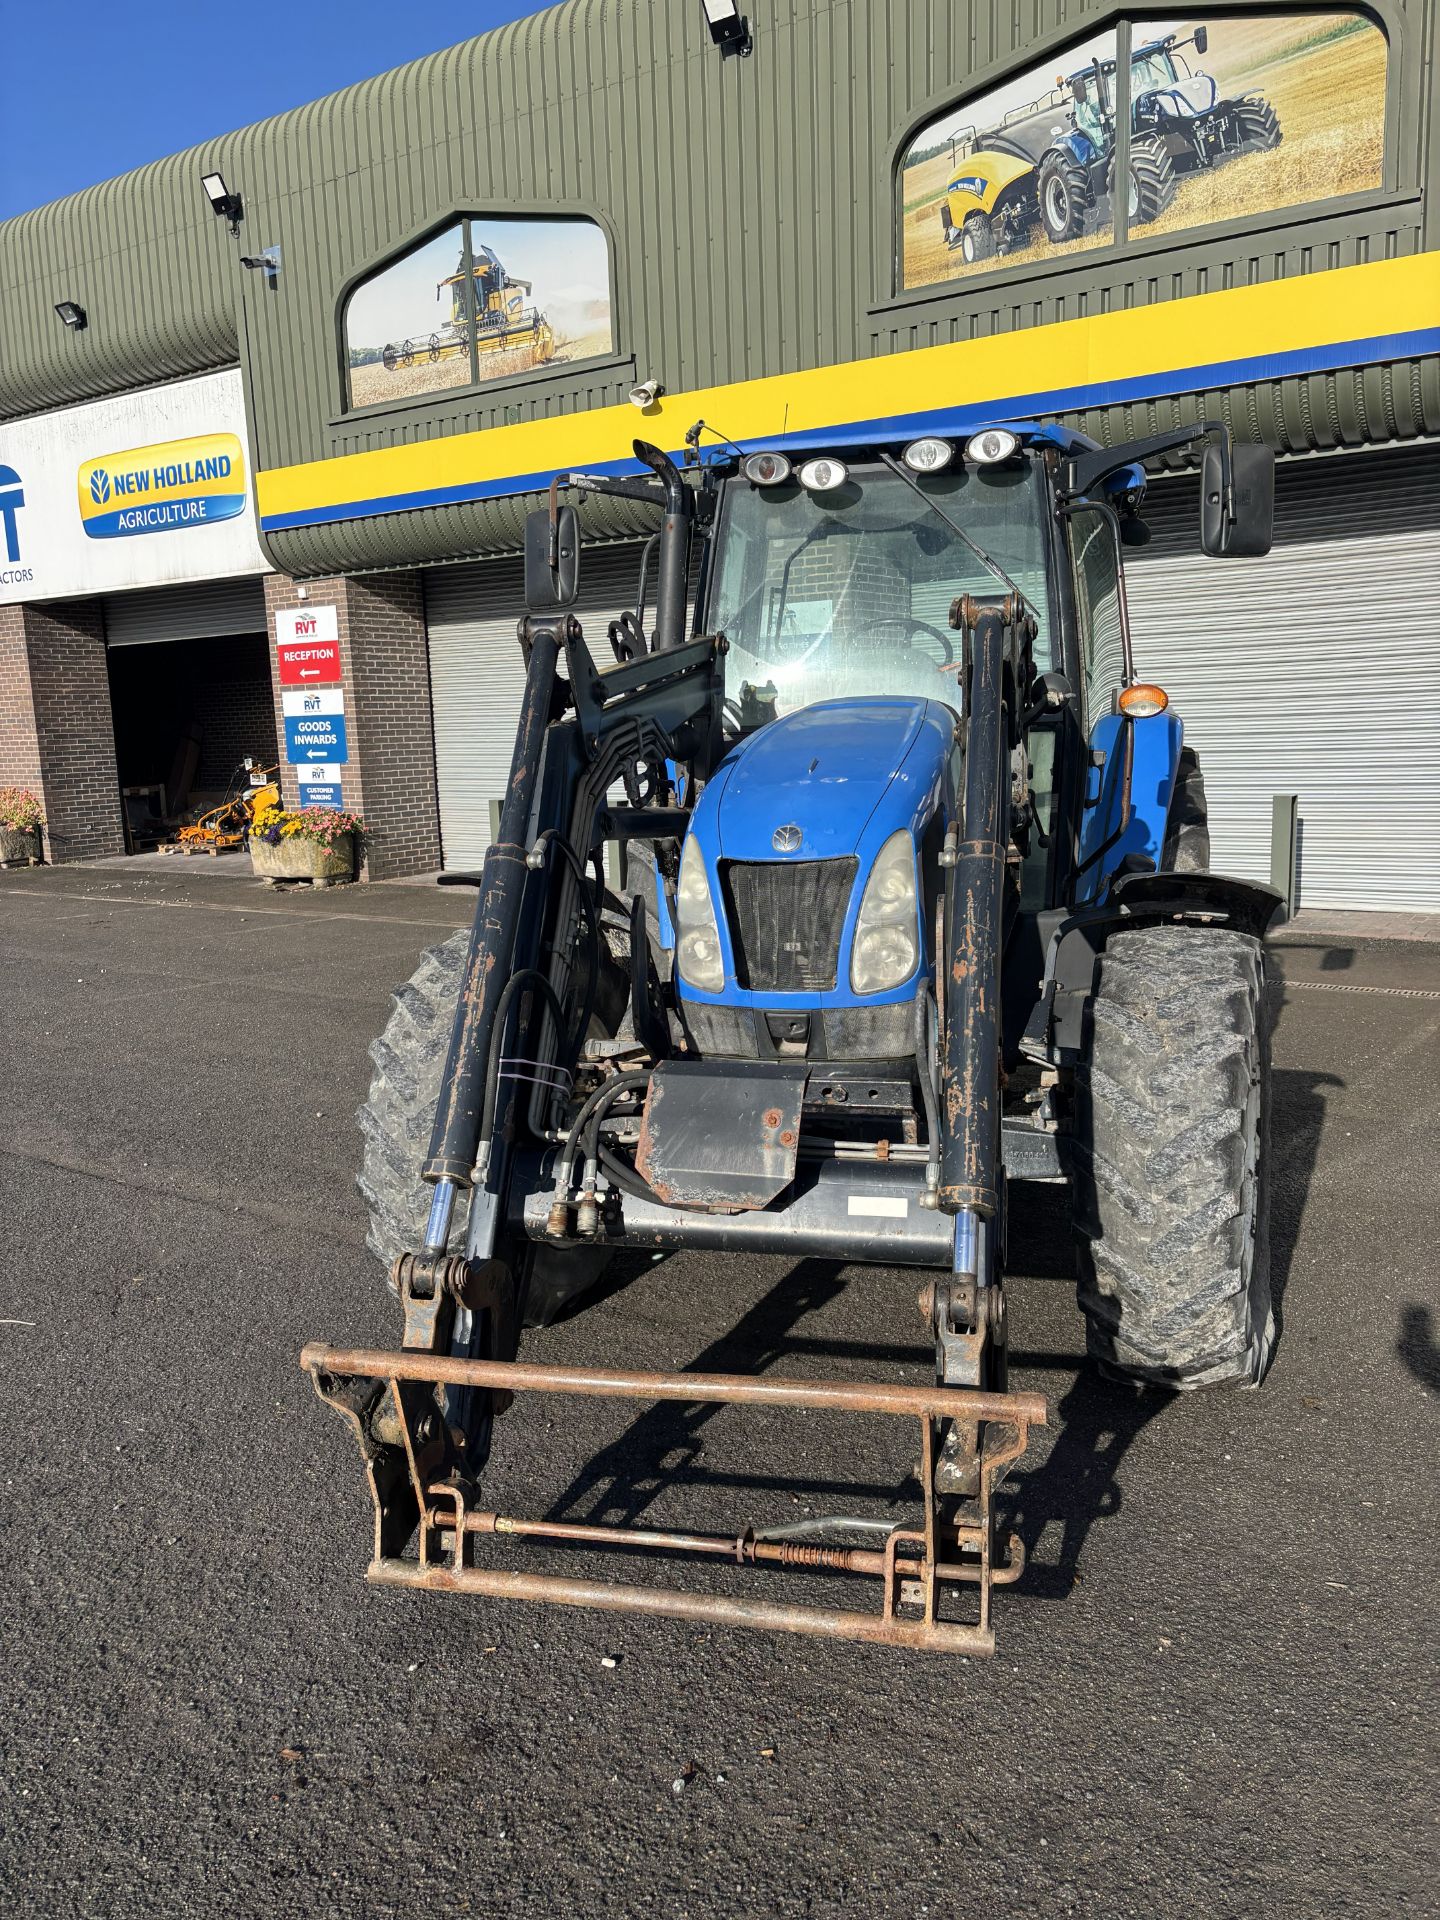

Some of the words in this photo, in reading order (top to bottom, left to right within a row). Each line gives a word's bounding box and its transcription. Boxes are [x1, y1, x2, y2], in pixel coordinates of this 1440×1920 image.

[114, 469, 150, 496] NEW
[153, 455, 231, 489] HOLLAND
[118, 500, 206, 530] AGRICULTURE
[295, 620, 317, 635] RVT
[284, 648, 334, 662] RECEPTION
[304, 699, 321, 710] RVT
[298, 721, 331, 732] GOODS
[294, 734, 337, 745] INWARDS
[312, 771, 325, 779] RVT
